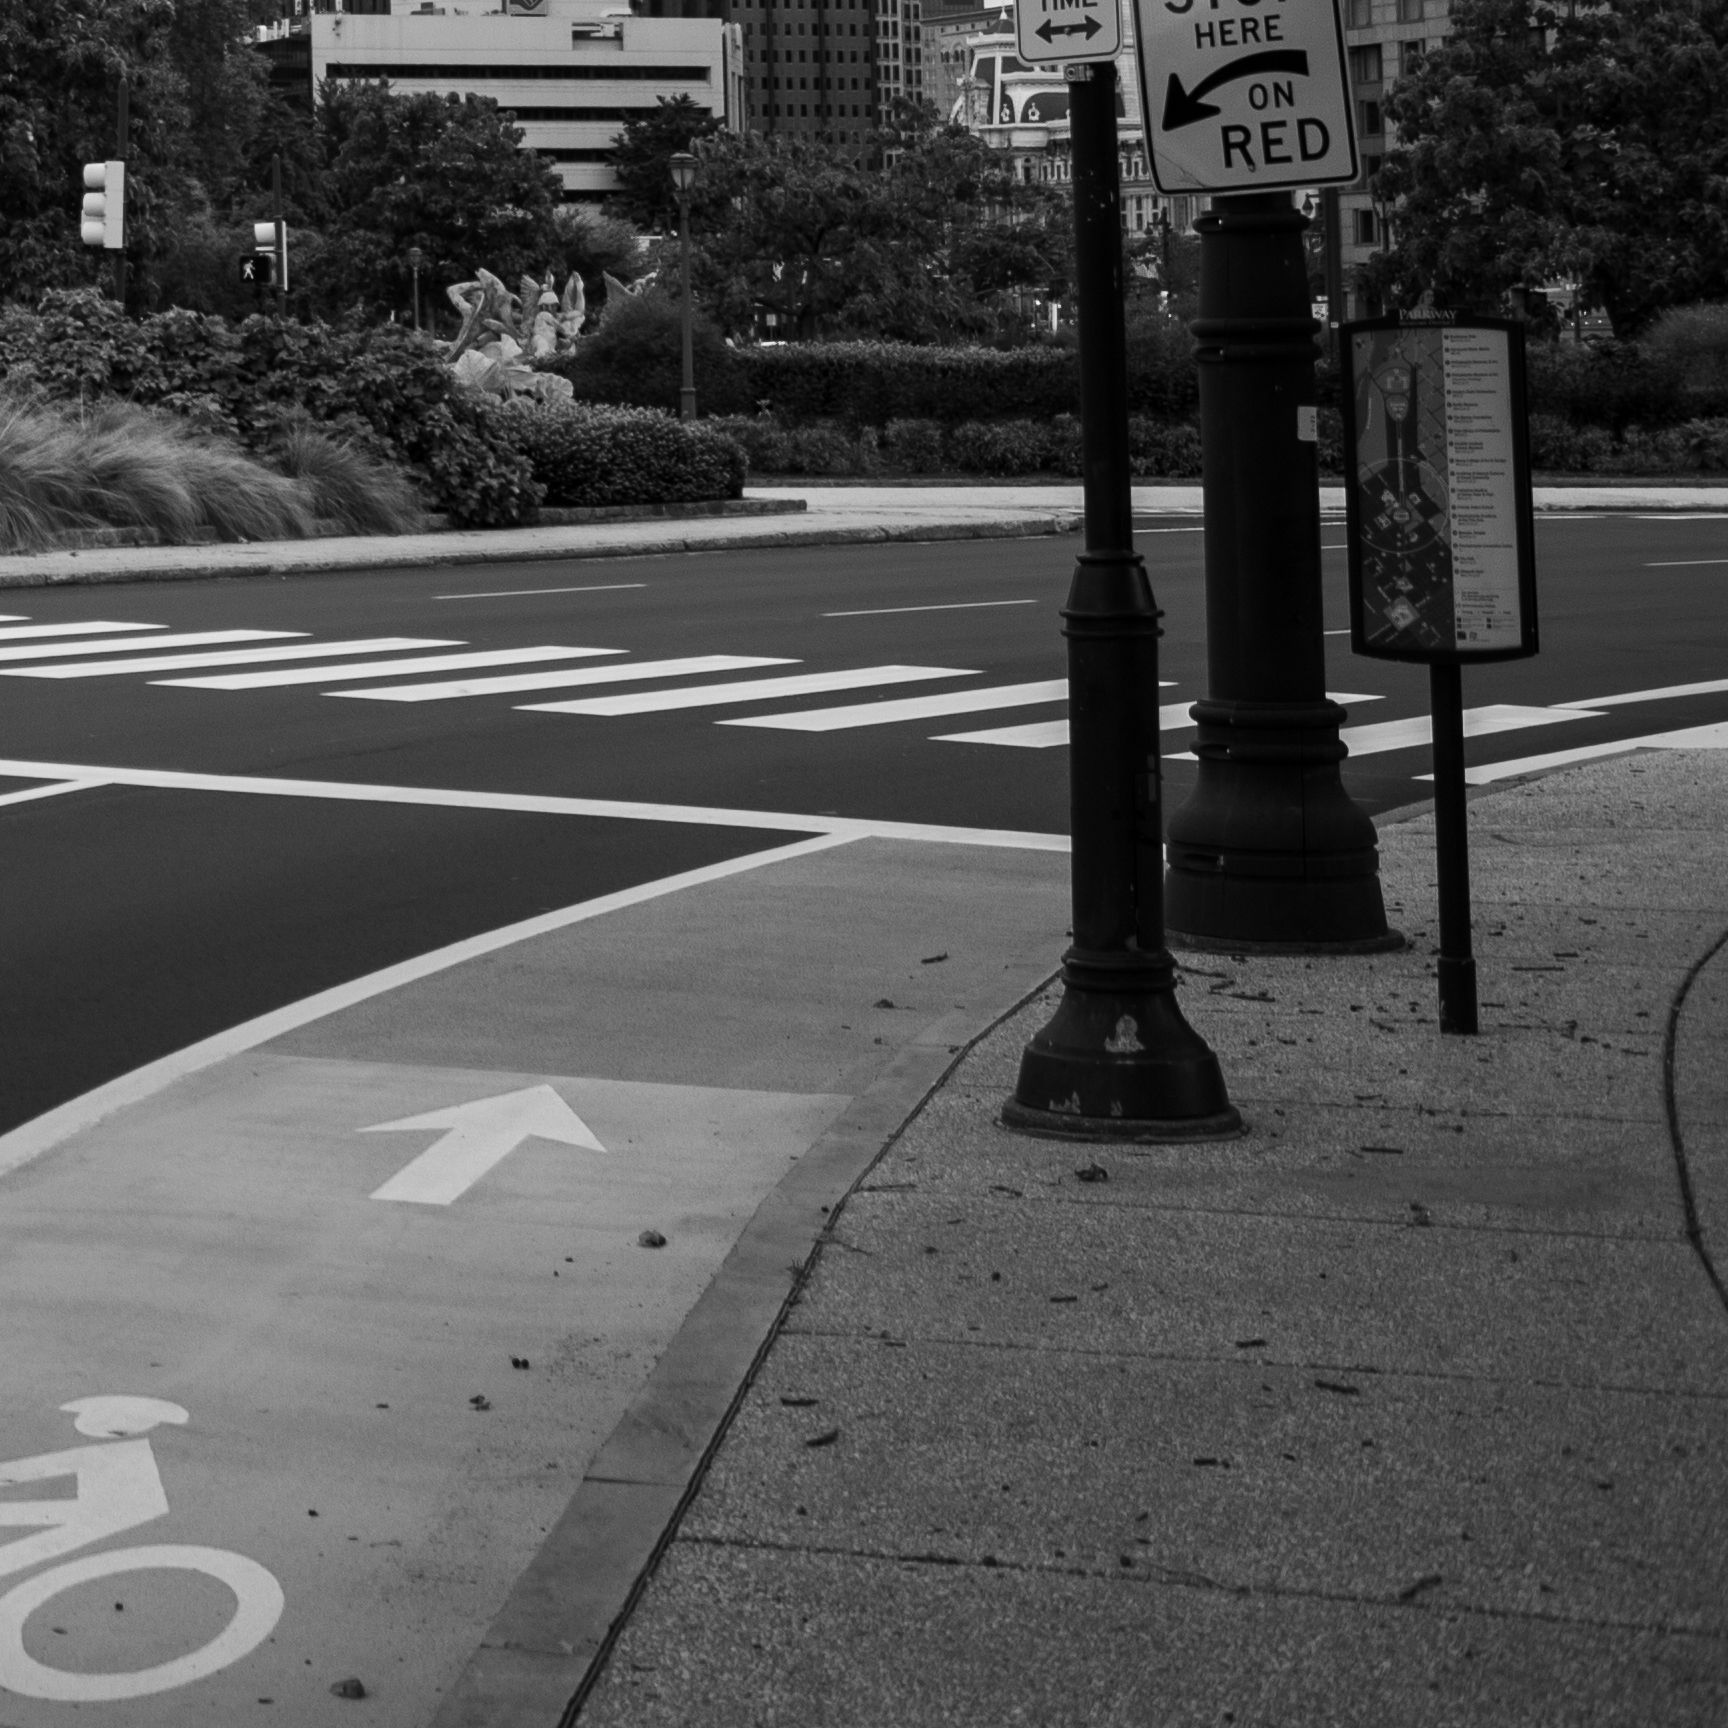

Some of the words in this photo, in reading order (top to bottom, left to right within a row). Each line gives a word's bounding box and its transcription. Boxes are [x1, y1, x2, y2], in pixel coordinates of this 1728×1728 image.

[1194, 13, 1284, 50] HERE
[1247, 80, 1295, 111] ON
[1221, 117, 1331, 169] RED
[1398, 307, 1458, 321] PARKWAY
